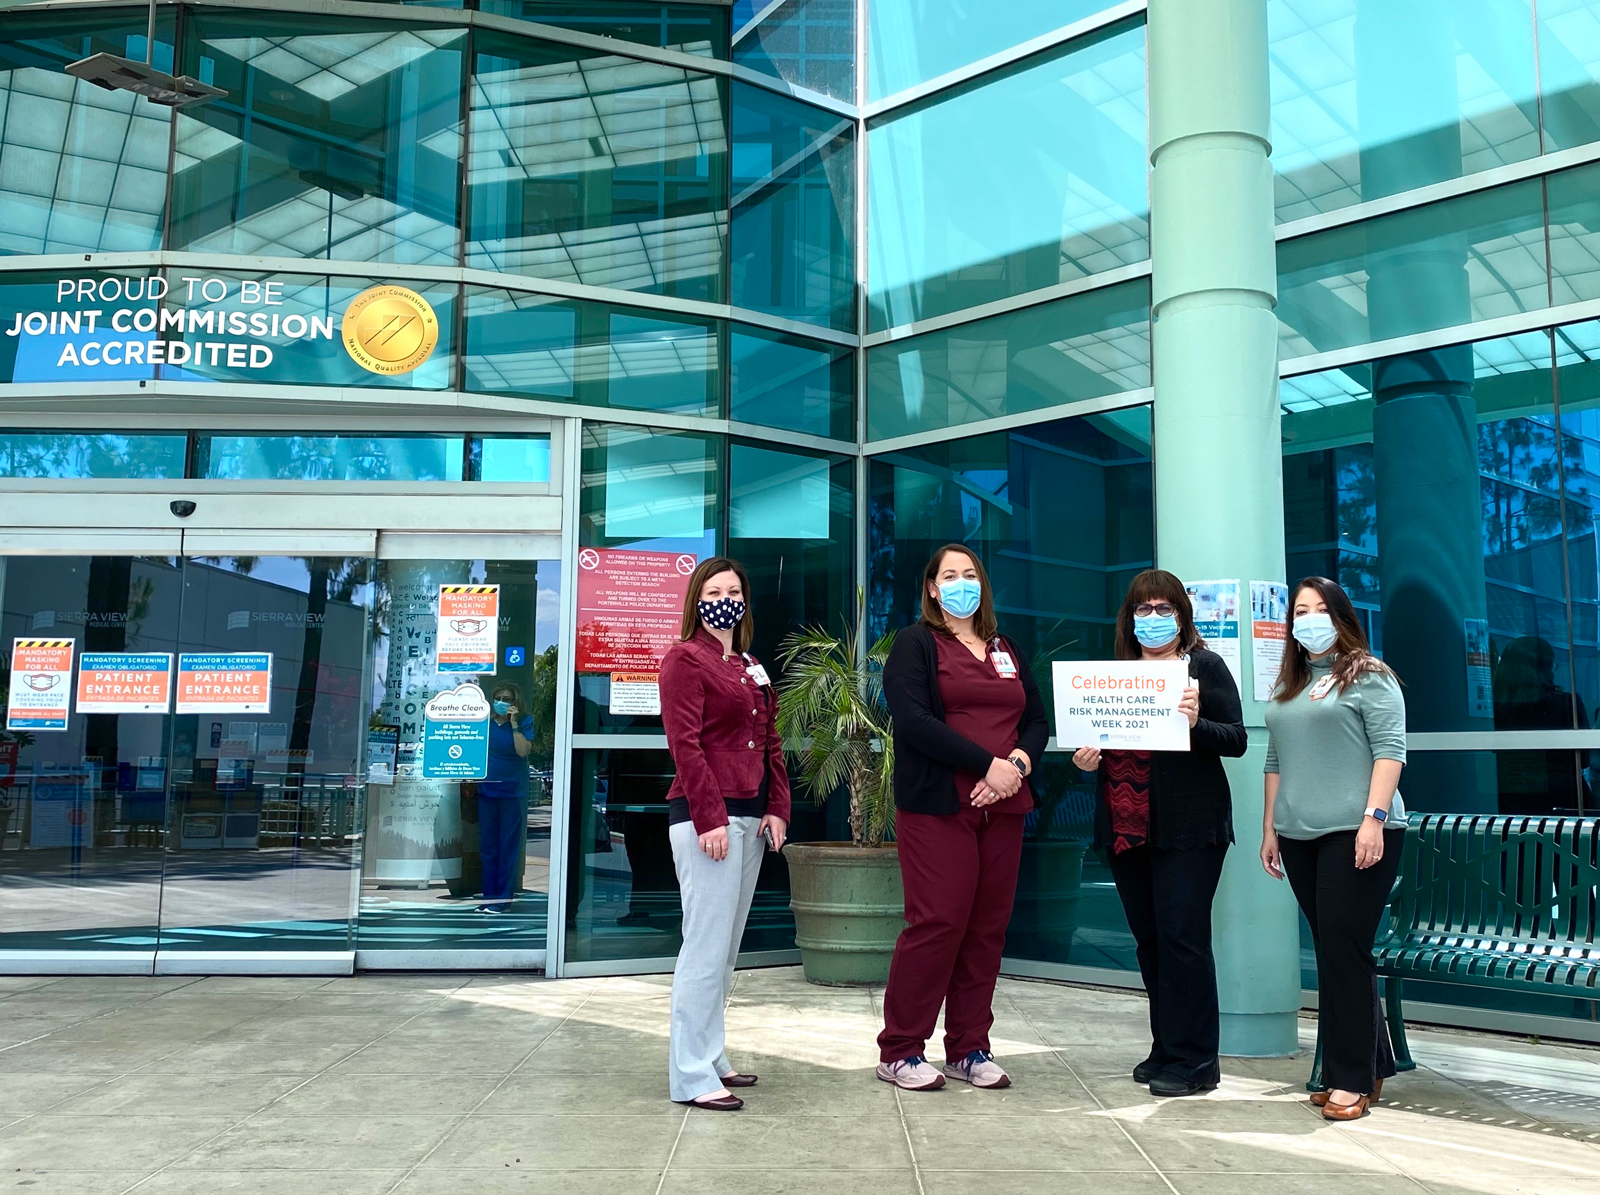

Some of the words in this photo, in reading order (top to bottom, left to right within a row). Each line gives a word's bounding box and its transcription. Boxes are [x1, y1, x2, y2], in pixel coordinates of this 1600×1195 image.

[57, 276, 169, 303] PROUD
[181, 277, 227, 301] TO
[240, 280, 284, 306] BE
[354, 299, 367, 308] THE
[368, 290, 387, 300] JOINT
[388, 289, 426, 312] COMMISSION
[5, 309, 103, 337] JOINT
[112, 308, 334, 340] COMMISSION
[56, 340, 274, 369] ACCREDITED
[348, 338, 371, 366] NATIONAL
[374, 363, 404, 372] QUALITY
[407, 342, 432, 367] APPROVAL
[57, 612, 98, 621] SIERRA
[101, 612, 130, 621] VIEW
[252, 612, 292, 621] SIERRA
[295, 613, 326, 622] VIEW
[95, 673, 152, 682] PATIENT
[195, 673, 252, 682] PATIENT
[1071, 675, 1166, 692] Celebrating
[86, 685, 160, 694] ENTRANCE
[186, 685, 259, 694] ENTRANCE
[1083, 696, 1123, 704] HEALTH
[1126, 696, 1156, 704] CARE
[1069, 708, 1092, 716] RISK
[1095, 708, 1172, 717] MANAGEMENT
[1091, 720, 1122, 728] WEEK
[1125, 720, 1150, 728] 2021
